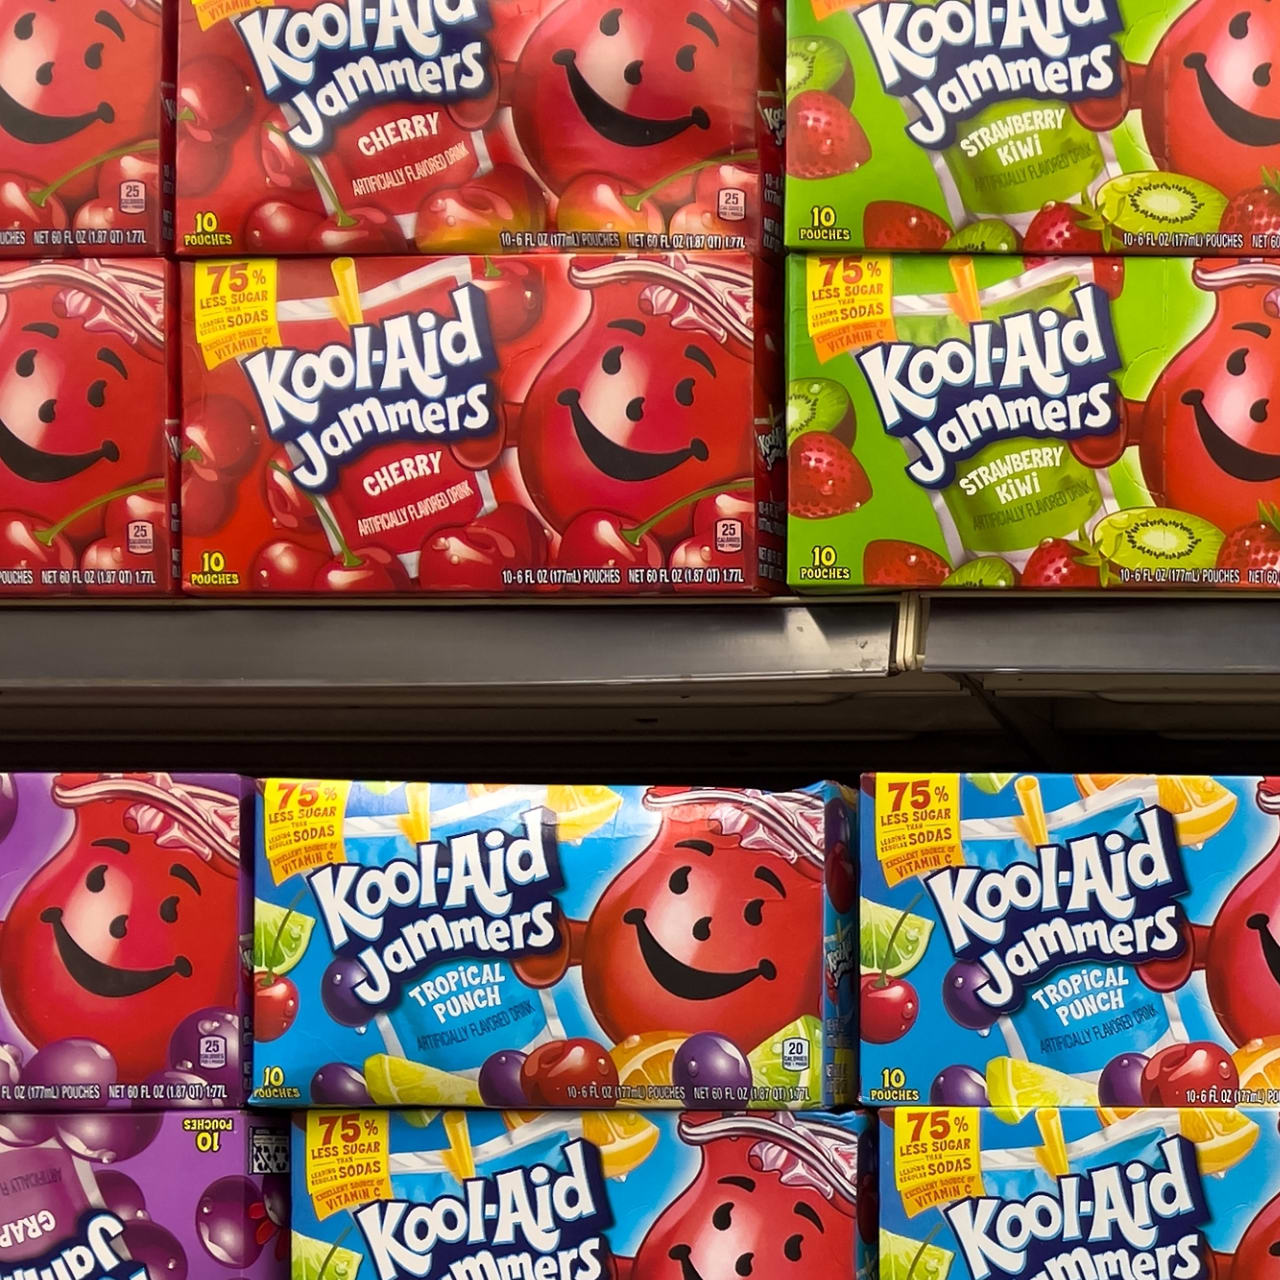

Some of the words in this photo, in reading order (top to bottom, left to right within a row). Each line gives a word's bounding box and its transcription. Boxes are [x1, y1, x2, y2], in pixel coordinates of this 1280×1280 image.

[288, 42, 484, 147] Jammers
[357, 112, 439, 156] CHERRY
[200, 296, 227, 310] LESS
[231, 290, 268, 304] SUGAR
[207, 263, 266, 295] 75%
[227, 309, 269, 328] SODAS
[246, 287, 482, 433] Kool-Aid
[860, 286, 1105, 429] Kool-Aid
[294, 384, 490, 487] Jammers
[910, 383, 1111, 482] Jammers
[363, 451, 442, 496] CHERRY
[959, 446, 1064, 495] STRAWBERRY
[358, 507, 409, 537] ARTIFICIALLY
[407, 492, 450, 520] FLAVORED
[446, 480, 474, 504] DRINK
[722, 523, 736, 536] 25
[191, 571, 240, 586] POUCHES
[201, 552, 224, 572] 10
[525, 569, 535, 584] FL
[537, 569, 548, 584] OZ
[583, 569, 621, 584] POUCHES
[628, 569, 645, 584] NET
[647, 569, 659, 584] 60
[660, 569, 670, 584] FL
[671, 569, 683, 584] OZ
[888, 780, 949, 812] 75%
[308, 804, 549, 946] Kool-Aid
[928, 809, 1172, 949] Kool-Aid
[355, 902, 555, 1003] Jammers
[977, 906, 1178, 1006] Jammers
[1056, 988, 1124, 1026] PUNCH
[183, 1119, 233, 1131] POUCHES
[196, 1132, 221, 1152] 10
[916, 1186, 961, 1209] VITAMIN
[965, 1185, 972, 1194] C
